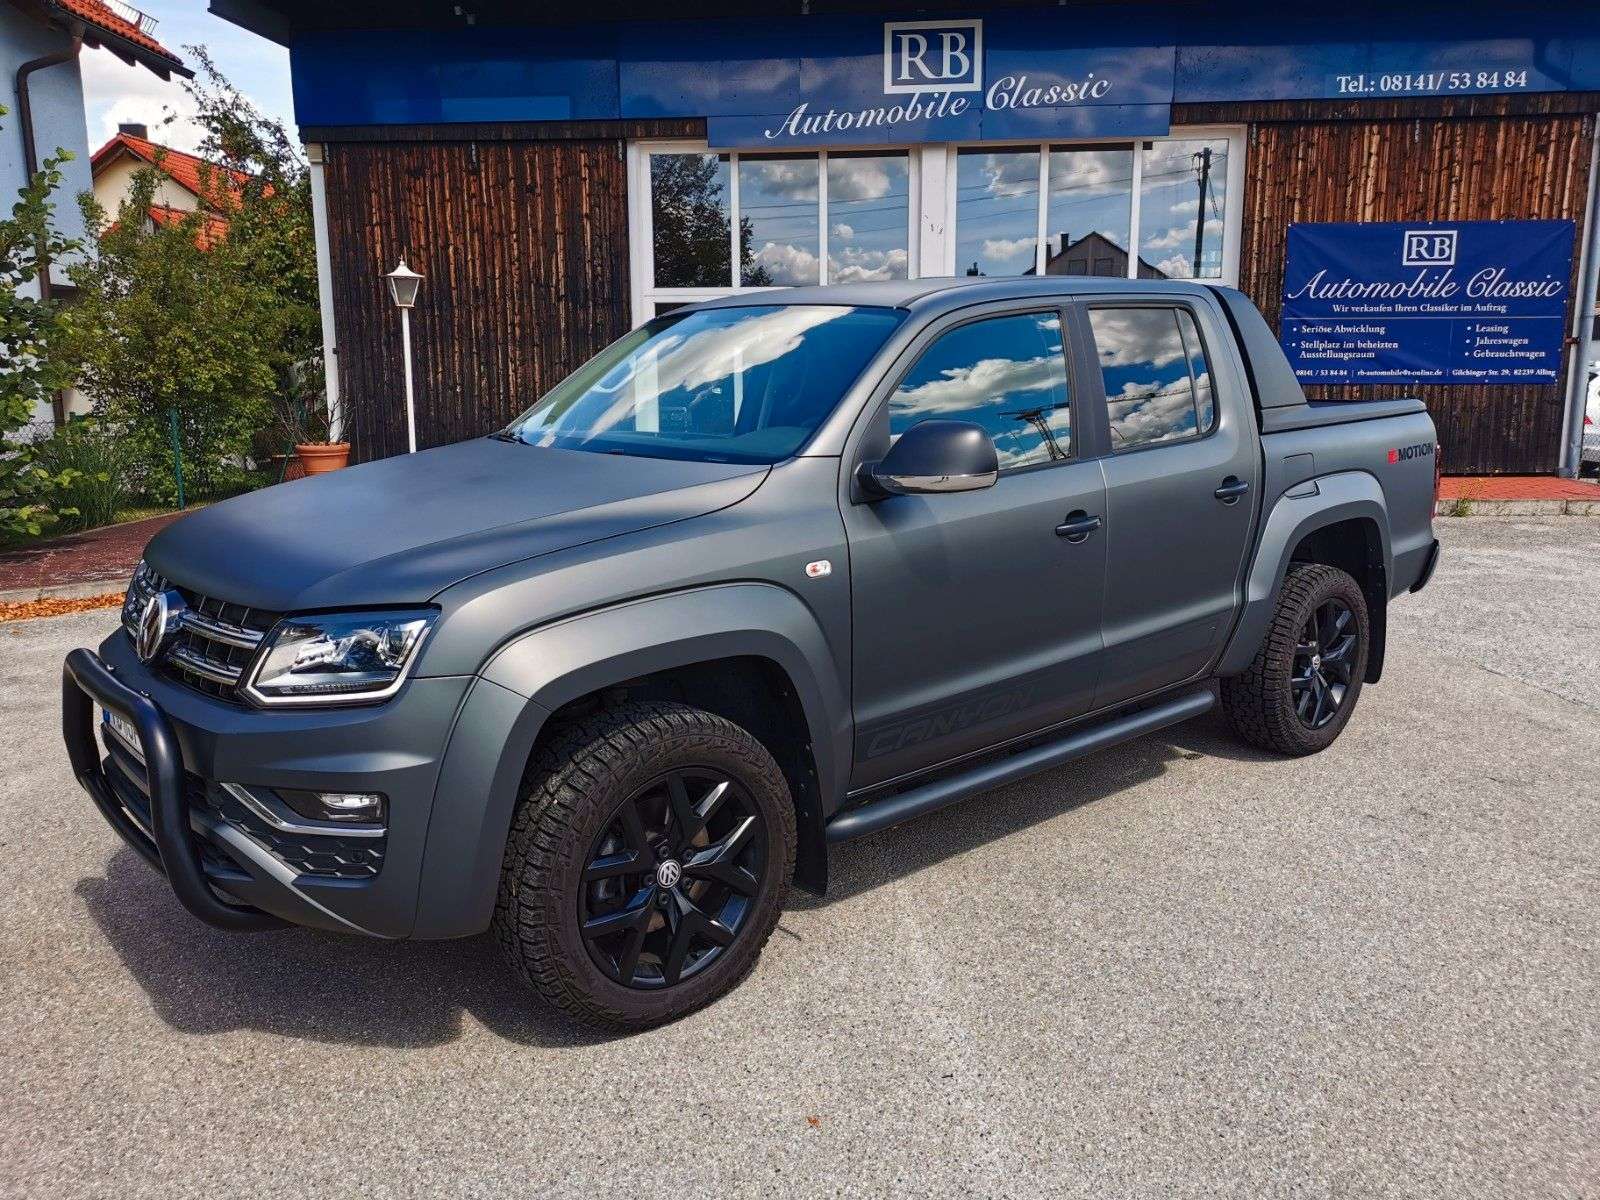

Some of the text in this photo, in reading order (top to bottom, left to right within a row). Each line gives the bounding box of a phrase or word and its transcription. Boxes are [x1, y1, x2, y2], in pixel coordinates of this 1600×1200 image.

[896, 31, 971, 81] RB
[1337, 74, 1375, 92] Tel.:
[1449, 72, 1471, 89] 53
[1476, 71, 1499, 88] 84
[1504, 70, 1527, 87] 84
[765, 73, 1112, 139] Automobile Classic
[1408, 236, 1451, 260] RB
[1287, 267, 1564, 299] Automobile Classic
[1333, 303, 1507, 313] Wir verkaufen Ihren Classiker im Auftrag
[1301, 325, 1386, 335] Seriöse Abwicklung
[1475, 324, 1509, 334] Leasing
[1300, 340, 1399, 351] Stellplatz im beheizten
[1474, 337, 1529, 347] Jahreswagen
[1299, 350, 1375, 360] Ausstellungsraum
[1473, 349, 1546, 359] Gebrauchtwagen
